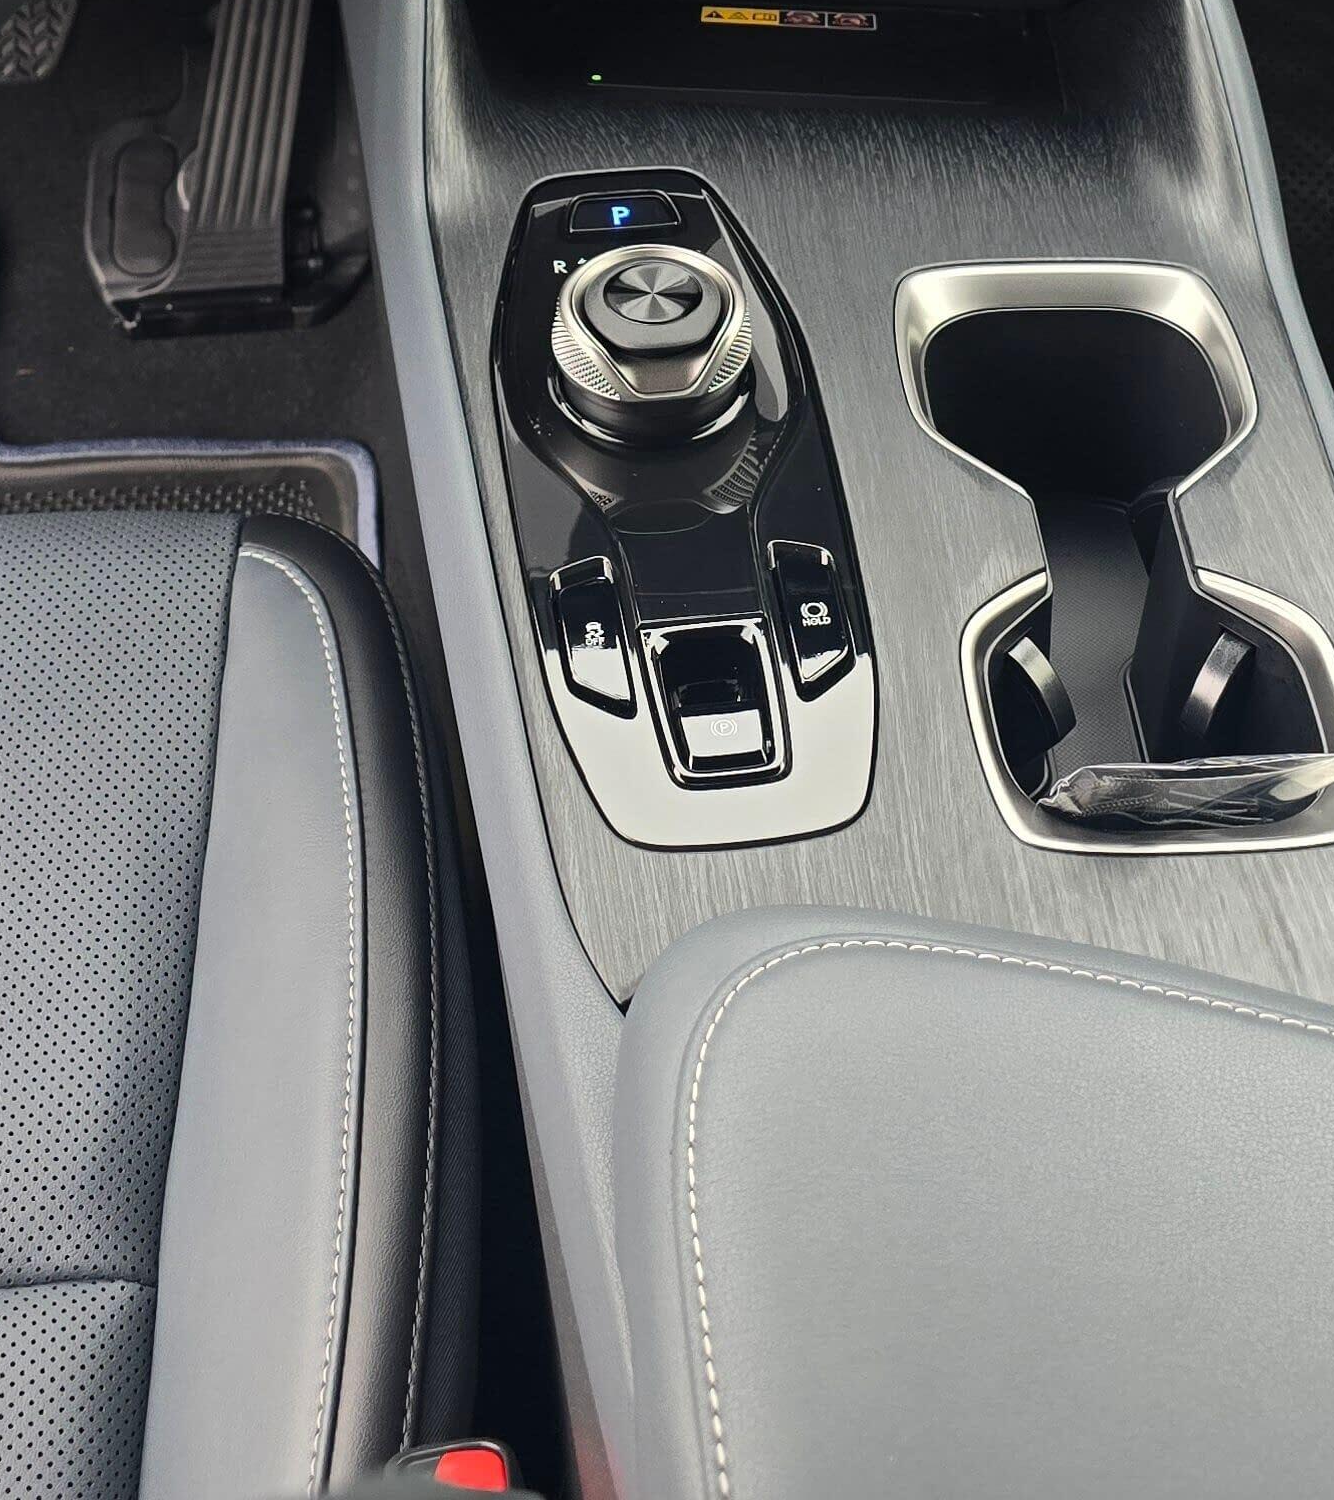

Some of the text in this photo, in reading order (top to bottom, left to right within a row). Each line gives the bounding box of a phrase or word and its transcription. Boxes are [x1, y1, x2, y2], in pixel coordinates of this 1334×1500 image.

[611, 206, 631, 226] P
[553, 260, 568, 274] R
[802, 616, 832, 627] HOLD
